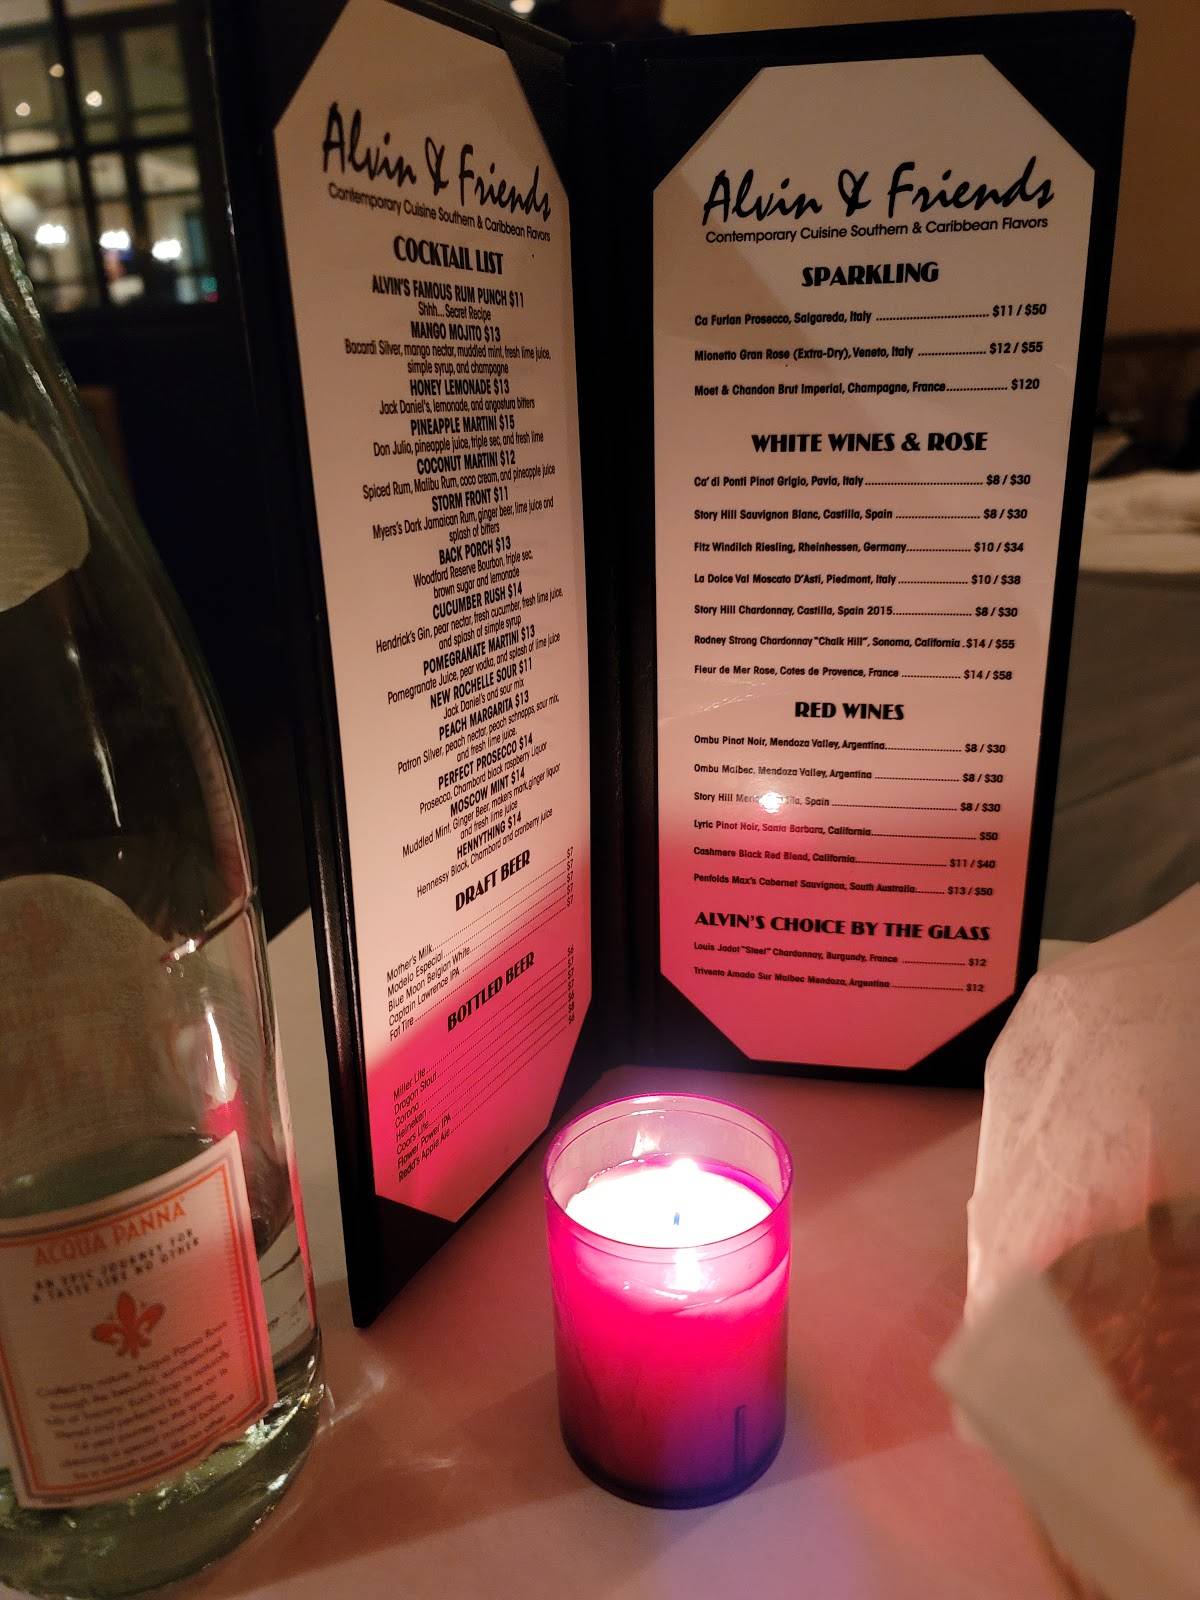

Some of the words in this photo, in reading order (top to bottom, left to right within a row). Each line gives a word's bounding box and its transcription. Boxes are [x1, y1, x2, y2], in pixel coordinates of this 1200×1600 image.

[322, 102, 416, 188] Alvin
[426, 136, 450, 196] &
[458, 144, 552, 222] Friends
[702, 170, 822, 226] Alvin
[838, 170, 872, 216] &
[888, 156, 1054, 218] Friends
[328, 183, 402, 215] Contemporary
[403, 199, 437, 220] Cuisine
[438, 207, 476, 227] Southern
[477, 215, 484, 230] &
[484, 217, 526, 237] Caribbean
[526, 225, 551, 242] Flavors
[706, 230, 798, 244] Contemporary
[800, 226, 848, 239] Cuisine
[850, 224, 909, 237] Southern
[912, 221, 922, 234] &
[925, 220, 999, 233] Caribbean
[1002, 217, 1048, 229] Flavors
[393, 237, 474, 270] COCKTAIL
[475, 250, 504, 275] LIST
[801, 262, 939, 287] SPARKLING
[372, 275, 411, 296] ALVIN'S
[412, 280, 453, 301] FAMOUS
[454, 285, 476, 303] RUM
[477, 288, 508, 306] PUNCH
[509, 290, 524, 308] $11
[695, 315, 708, 326] Ca
[744, 314, 792, 325] Prosecco,
[850, 311, 873, 324] Italy
[992, 304, 1013, 318] $11
[1016, 304, 1023, 317] /
[1024, 303, 1047, 316] $50
[411, 321, 447, 340] MANGO
[449, 324, 482, 341] MOJITO
[484, 325, 501, 343] $13
[695, 350, 737, 361] Mionetto
[739, 349, 763, 361] Gran
[766, 349, 791, 360] Rose
[852, 347, 890, 358] Veneto,
[891, 346, 914, 359] Italy
[989, 342, 1012, 355] $12
[1013, 342, 1020, 354] /
[1021, 341, 1044, 354] $55
[409, 379, 442, 396] HONEY
[444, 379, 492, 396] LEMONADE
[493, 378, 510, 395] $13
[410, 417, 461, 436] PINEAPPLE
[463, 415, 498, 433] MARTINI
[499, 414, 515, 432] $15
[751, 434, 823, 453] WHITE
[828, 433, 896, 452] WINES
[901, 432, 921, 452] &
[927, 432, 988, 451] ROSE
[417, 455, 462, 475] COCONUT
[464, 452, 498, 470] MARTINI
[500, 449, 516, 467] $12
[432, 493, 463, 512] STORM
[465, 488, 491, 507] FRONT
[494, 486, 509, 503] $11
[694, 509, 718, 522] Story
[721, 509, 737, 520] Hill
[740, 509, 789, 521] Sauvignon
[792, 509, 821, 520] Blanc,
[823, 509, 863, 520] Castilla,
[865, 509, 893, 521] Spain
[983, 508, 998, 520] $8
[999, 509, 1006, 520] /
[1007, 508, 1028, 520] $30
[439, 546, 464, 565] BACK
[465, 539, 494, 559] PORCH
[495, 535, 512, 553] $13
[694, 574, 705, 583] La
[708, 574, 734, 584] Dolce
[753, 574, 792, 584] Moscato
[826, 574, 874, 584] Piedmont,
[876, 574, 897, 586] Italy
[971, 574, 992, 585] $10
[993, 574, 999, 585] /
[1001, 574, 1021, 585] $38
[433, 593, 483, 619] CUCUMBER
[484, 586, 506, 605] RUSH
[508, 581, 523, 599] $14
[423, 642, 486, 675] POMEGRANATE
[488, 630, 519, 652] MARTINI
[521, 624, 536, 642] $13
[430, 688, 451, 709] NEW
[453, 672, 495, 700] ROCHELLE
[496, 663, 518, 683] SOUR
[519, 657, 532, 675] $11
[695, 665, 717, 674] Fleur
[719, 665, 730, 675] de
[733, 665, 751, 674] Mer
[754, 666, 778, 676] Rose,
[780, 666, 806, 676] Cotes
[808, 667, 820, 676] de
[822, 667, 866, 677] Provence,
[868, 668, 899, 678] France
[963, 669, 983, 680] $14
[985, 670, 991, 680] /
[992, 670, 1013, 681] $58
[439, 717, 467, 741] PEACH
[470, 698, 514, 727] MARGARITA
[515, 690, 529, 708] $13
[795, 702, 837, 718] RED
[842, 703, 904, 720] WINES
[439, 761, 474, 790] PERFECT
[477, 741, 517, 771] PROSECCO
[519, 733, 533, 751] $14
[694, 763, 719, 773] Ombu
[758, 766, 798, 776] Mendoza
[799, 768, 828, 779] Valley,
[829, 769, 872, 780] Argentina
[962, 773, 976, 783] $8
[977, 773, 983, 783] /
[984, 773, 1004, 784] $30
[450, 786, 489, 817] MOSCOW
[491, 775, 509, 796] MINT
[511, 766, 525, 785] $14
[457, 821, 506, 859] HENNYTHING
[508, 811, 522, 830] $14
[455, 870, 498, 911] DRAFT
[501, 850, 531, 881] BEER
[695, 912, 765, 929] ALVIN'S
[770, 917, 846, 934] CHOICE
[851, 921, 879, 936] BY
[883, 923, 923, 938] THE
[928, 925, 990, 941] GLASS
[448, 977, 503, 1031] BOTTLED
[506, 952, 535, 986] BEER
[36, 1234, 108, 1266] ACQUA
[112, 1200, 186, 1244] PANNA
